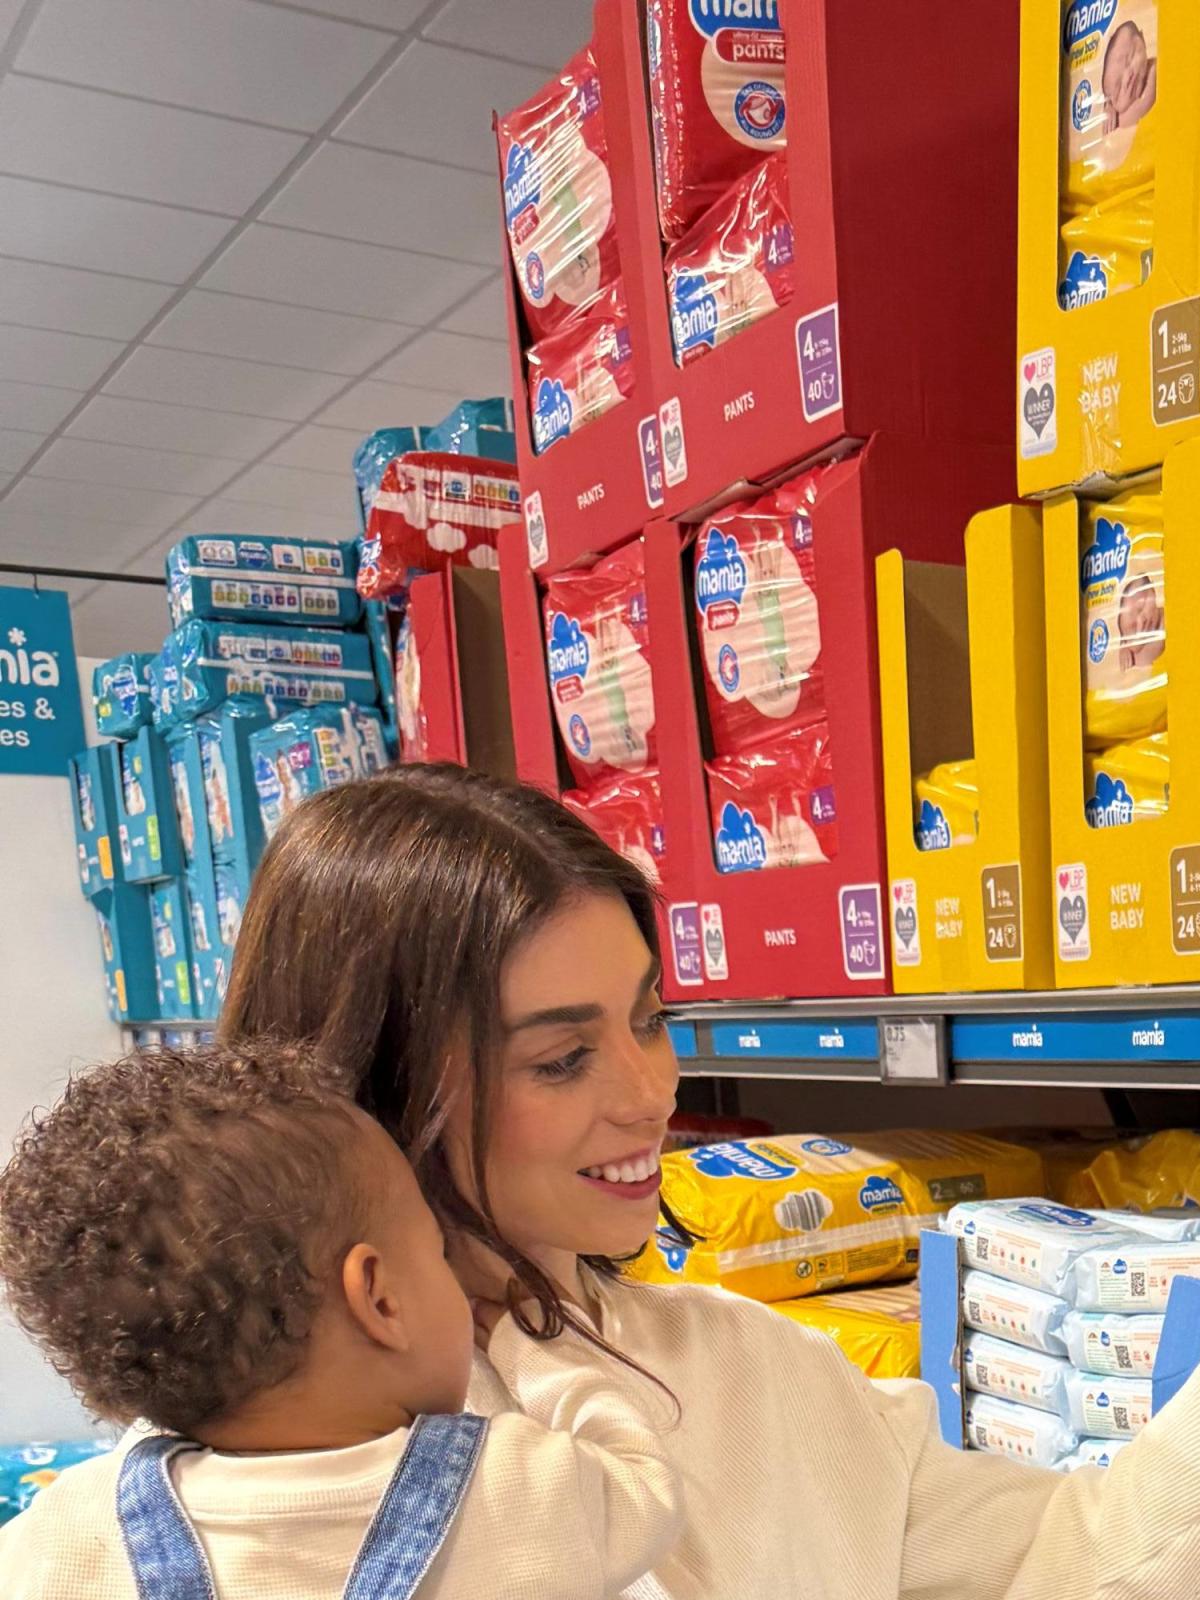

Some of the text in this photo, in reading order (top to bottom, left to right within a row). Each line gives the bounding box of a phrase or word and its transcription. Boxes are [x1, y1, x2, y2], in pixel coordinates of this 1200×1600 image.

[732, 42, 785, 62] pants
[803, 331, 816, 360] 4
[1157, 320, 1169, 359] 1
[1082, 355, 1119, 384] NEW
[808, 378, 822, 398] 40
[1080, 383, 1121, 414] BABY
[1157, 380, 1178, 409] 24
[723, 392, 755, 422] PANTS
[1027, 397, 1052, 416] WINNER
[576, 484, 605, 509] PANTS
[794, 523, 806, 543] 4
[699, 547, 745, 592] mamia
[34, 697, 57, 720] &
[0, 730, 31, 747] es
[985, 877, 997, 909] 1
[1110, 882, 1142, 905] NEW
[846, 900, 858, 928] 4
[935, 898, 961, 917] NEW
[935, 920, 963, 940] BABY
[1110, 908, 1145, 931] BABY
[1177, 915, 1195, 939] 24
[764, 929, 797, 948] PANTS
[987, 927, 1004, 949] 24
[849, 944, 864, 964] 40
[1012, 1024, 1043, 1047] mamia
[1132, 1021, 1166, 1047] mamia
